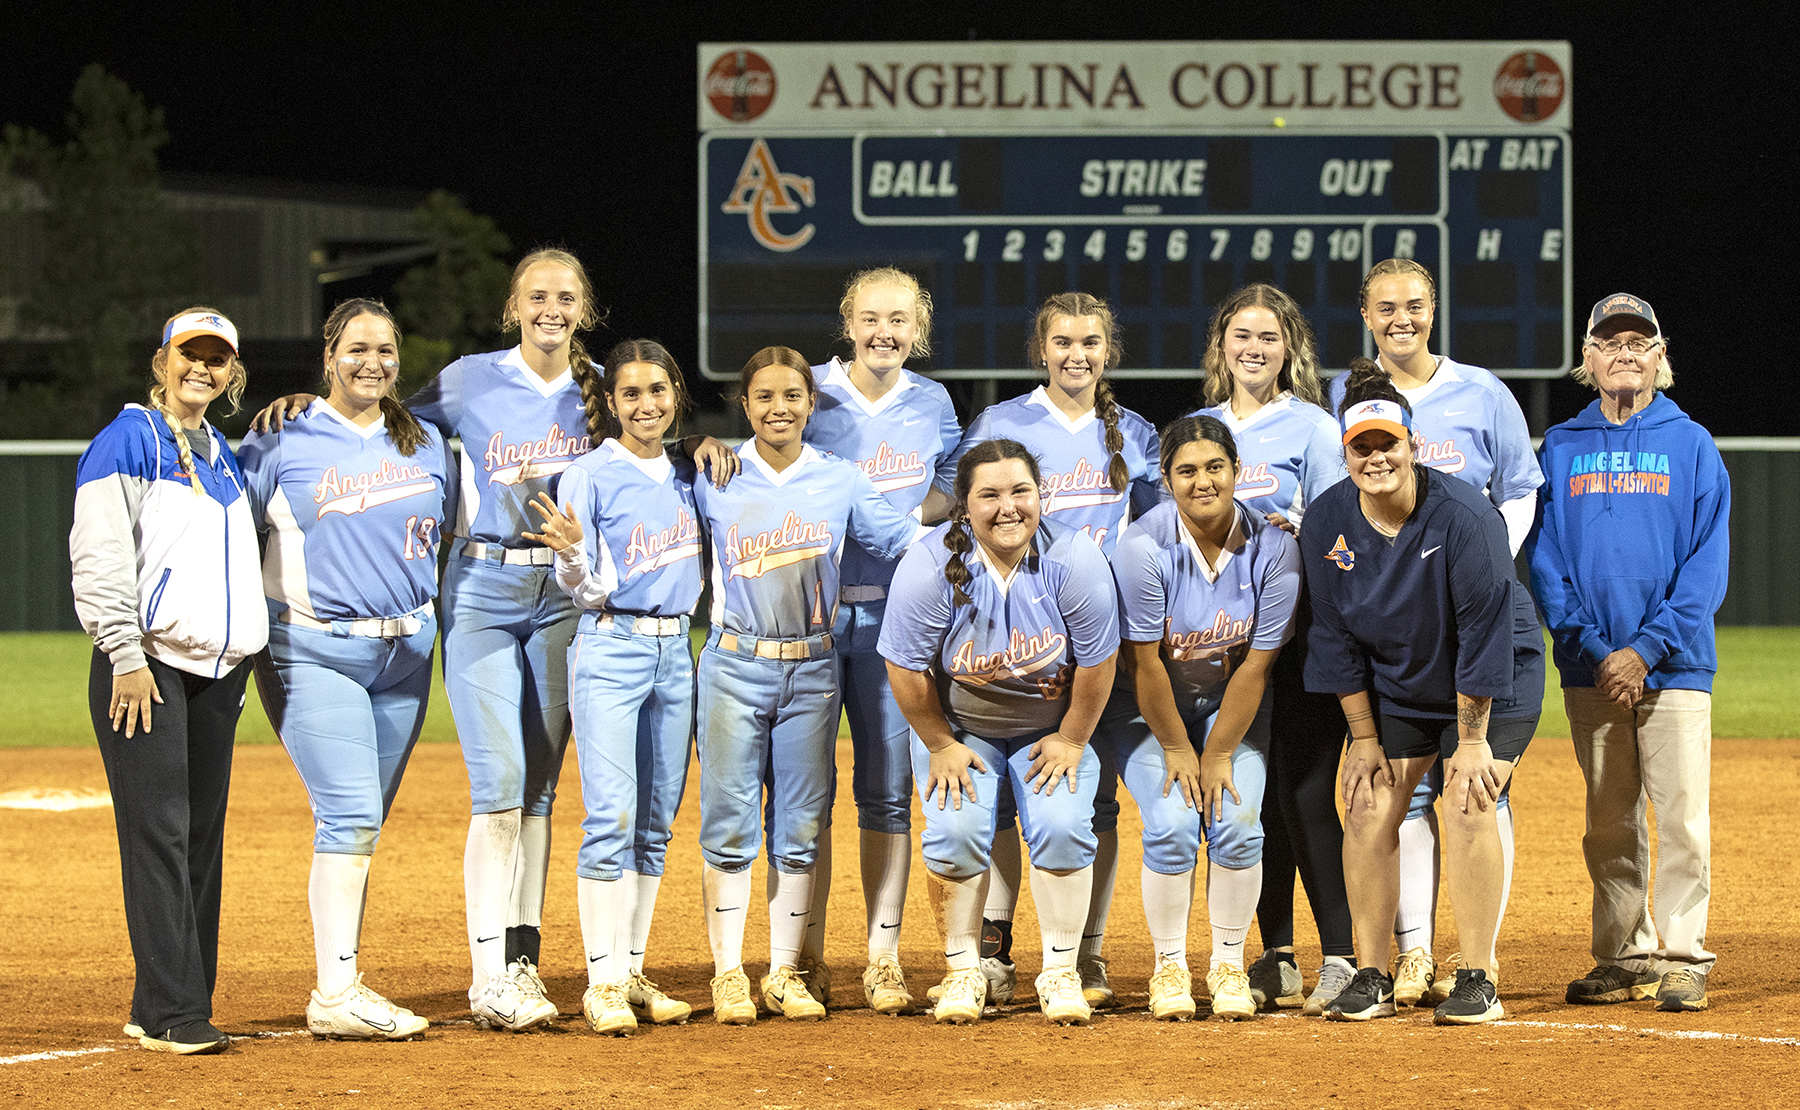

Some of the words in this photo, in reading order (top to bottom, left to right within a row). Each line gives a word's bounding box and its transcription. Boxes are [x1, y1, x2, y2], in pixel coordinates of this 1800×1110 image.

[809, 62, 1146, 109] ANGELINA
[1170, 62, 1462, 110] COLLEGE
[869, 160, 958, 198] BALL
[1080, 159, 1207, 197] STRIKE
[1320, 159, 1393, 197] OUT
[1450, 140, 1490, 171] AT
[1500, 140, 1560, 171] BAT
[963, 229, 980, 261] 1
[1002, 229, 1025, 261] 2
[1043, 229, 1065, 261] 3
[1084, 229, 1106, 261] 4
[1126, 229, 1147, 261] 5
[1166, 229, 1188, 261] 6
[1210, 229, 1231, 261] 7
[1251, 229, 1274, 261] 8
[1292, 229, 1315, 261] 9
[1327, 229, 1361, 261] 10
[1394, 229, 1417, 259] R
[1477, 229, 1502, 261] H
[1540, 229, 1563, 261] E
[484, 422, 593, 484] Angelina
[855, 440, 922, 479] elina
[1569, 451, 1670, 476] ANGELINA
[314, 457, 430, 512] Angelina
[1040, 457, 1111, 515] gelin
[624, 506, 700, 571] Angelin
[725, 510, 832, 578] Angelina
[811, 580, 823, 625] 1
